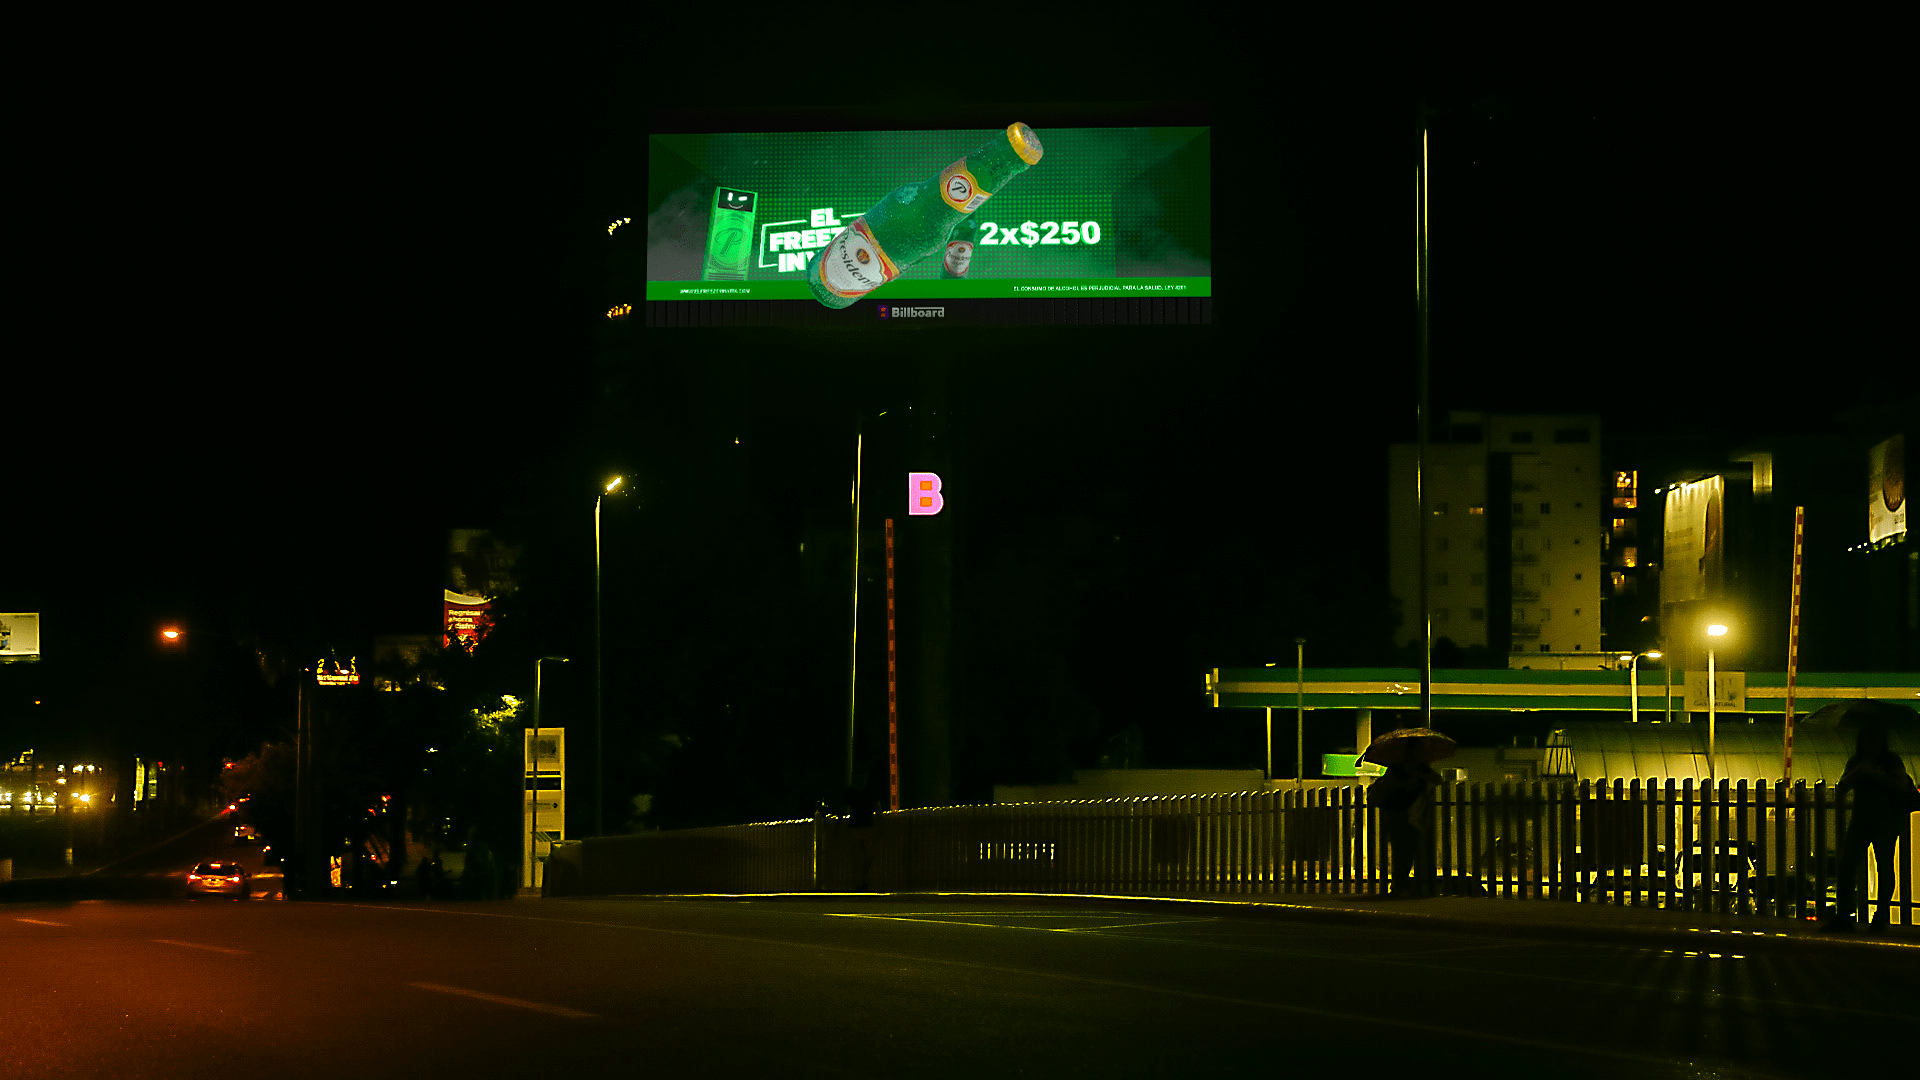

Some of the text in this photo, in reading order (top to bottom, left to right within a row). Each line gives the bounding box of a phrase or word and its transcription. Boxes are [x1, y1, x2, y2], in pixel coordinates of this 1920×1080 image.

[811, 208, 841, 228] EL
[770, 226, 847, 252] FREEZ
[980, 220, 1100, 248] 2x$250
[892, 307, 945, 318] Billboard
[908, 472, 944, 516] B
